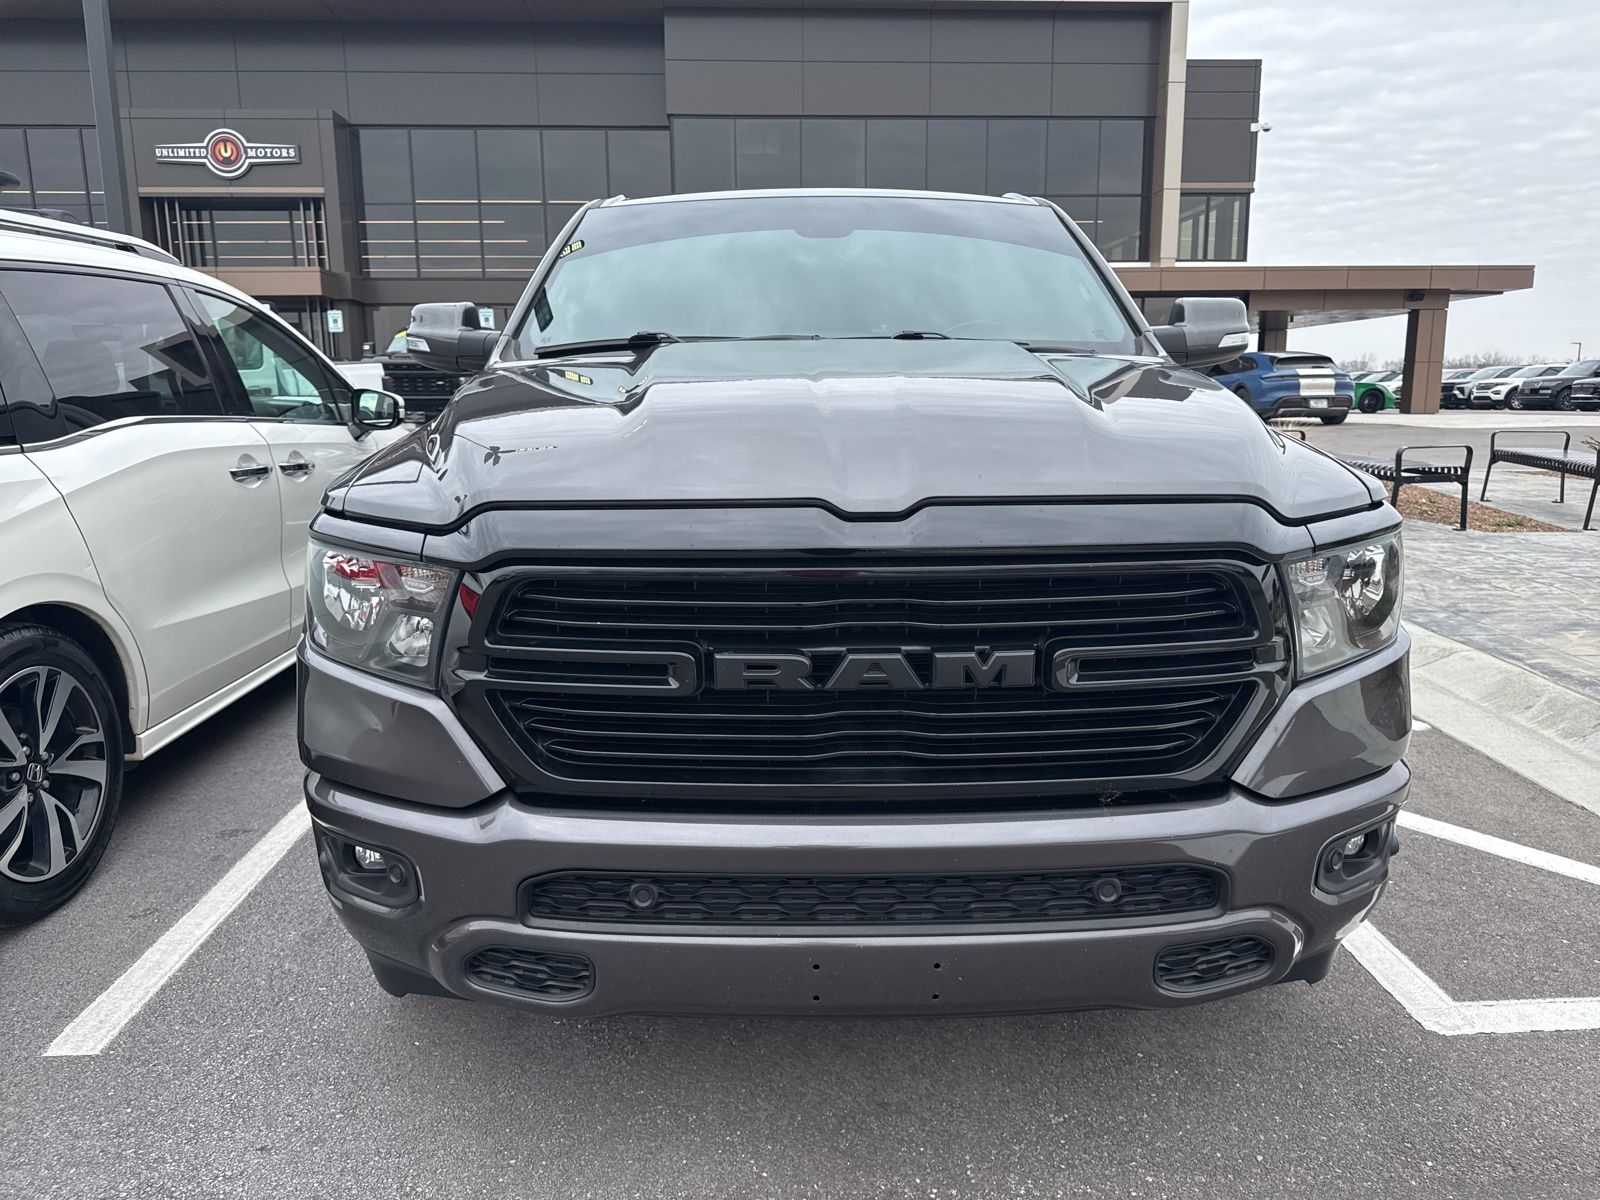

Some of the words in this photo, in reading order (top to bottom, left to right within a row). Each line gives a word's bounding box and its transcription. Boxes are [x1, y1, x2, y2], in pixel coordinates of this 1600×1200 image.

[155, 148, 207, 157] UNLIMITED
[247, 148, 296, 157] MOTORS
[713, 650, 1036, 690] RAM
